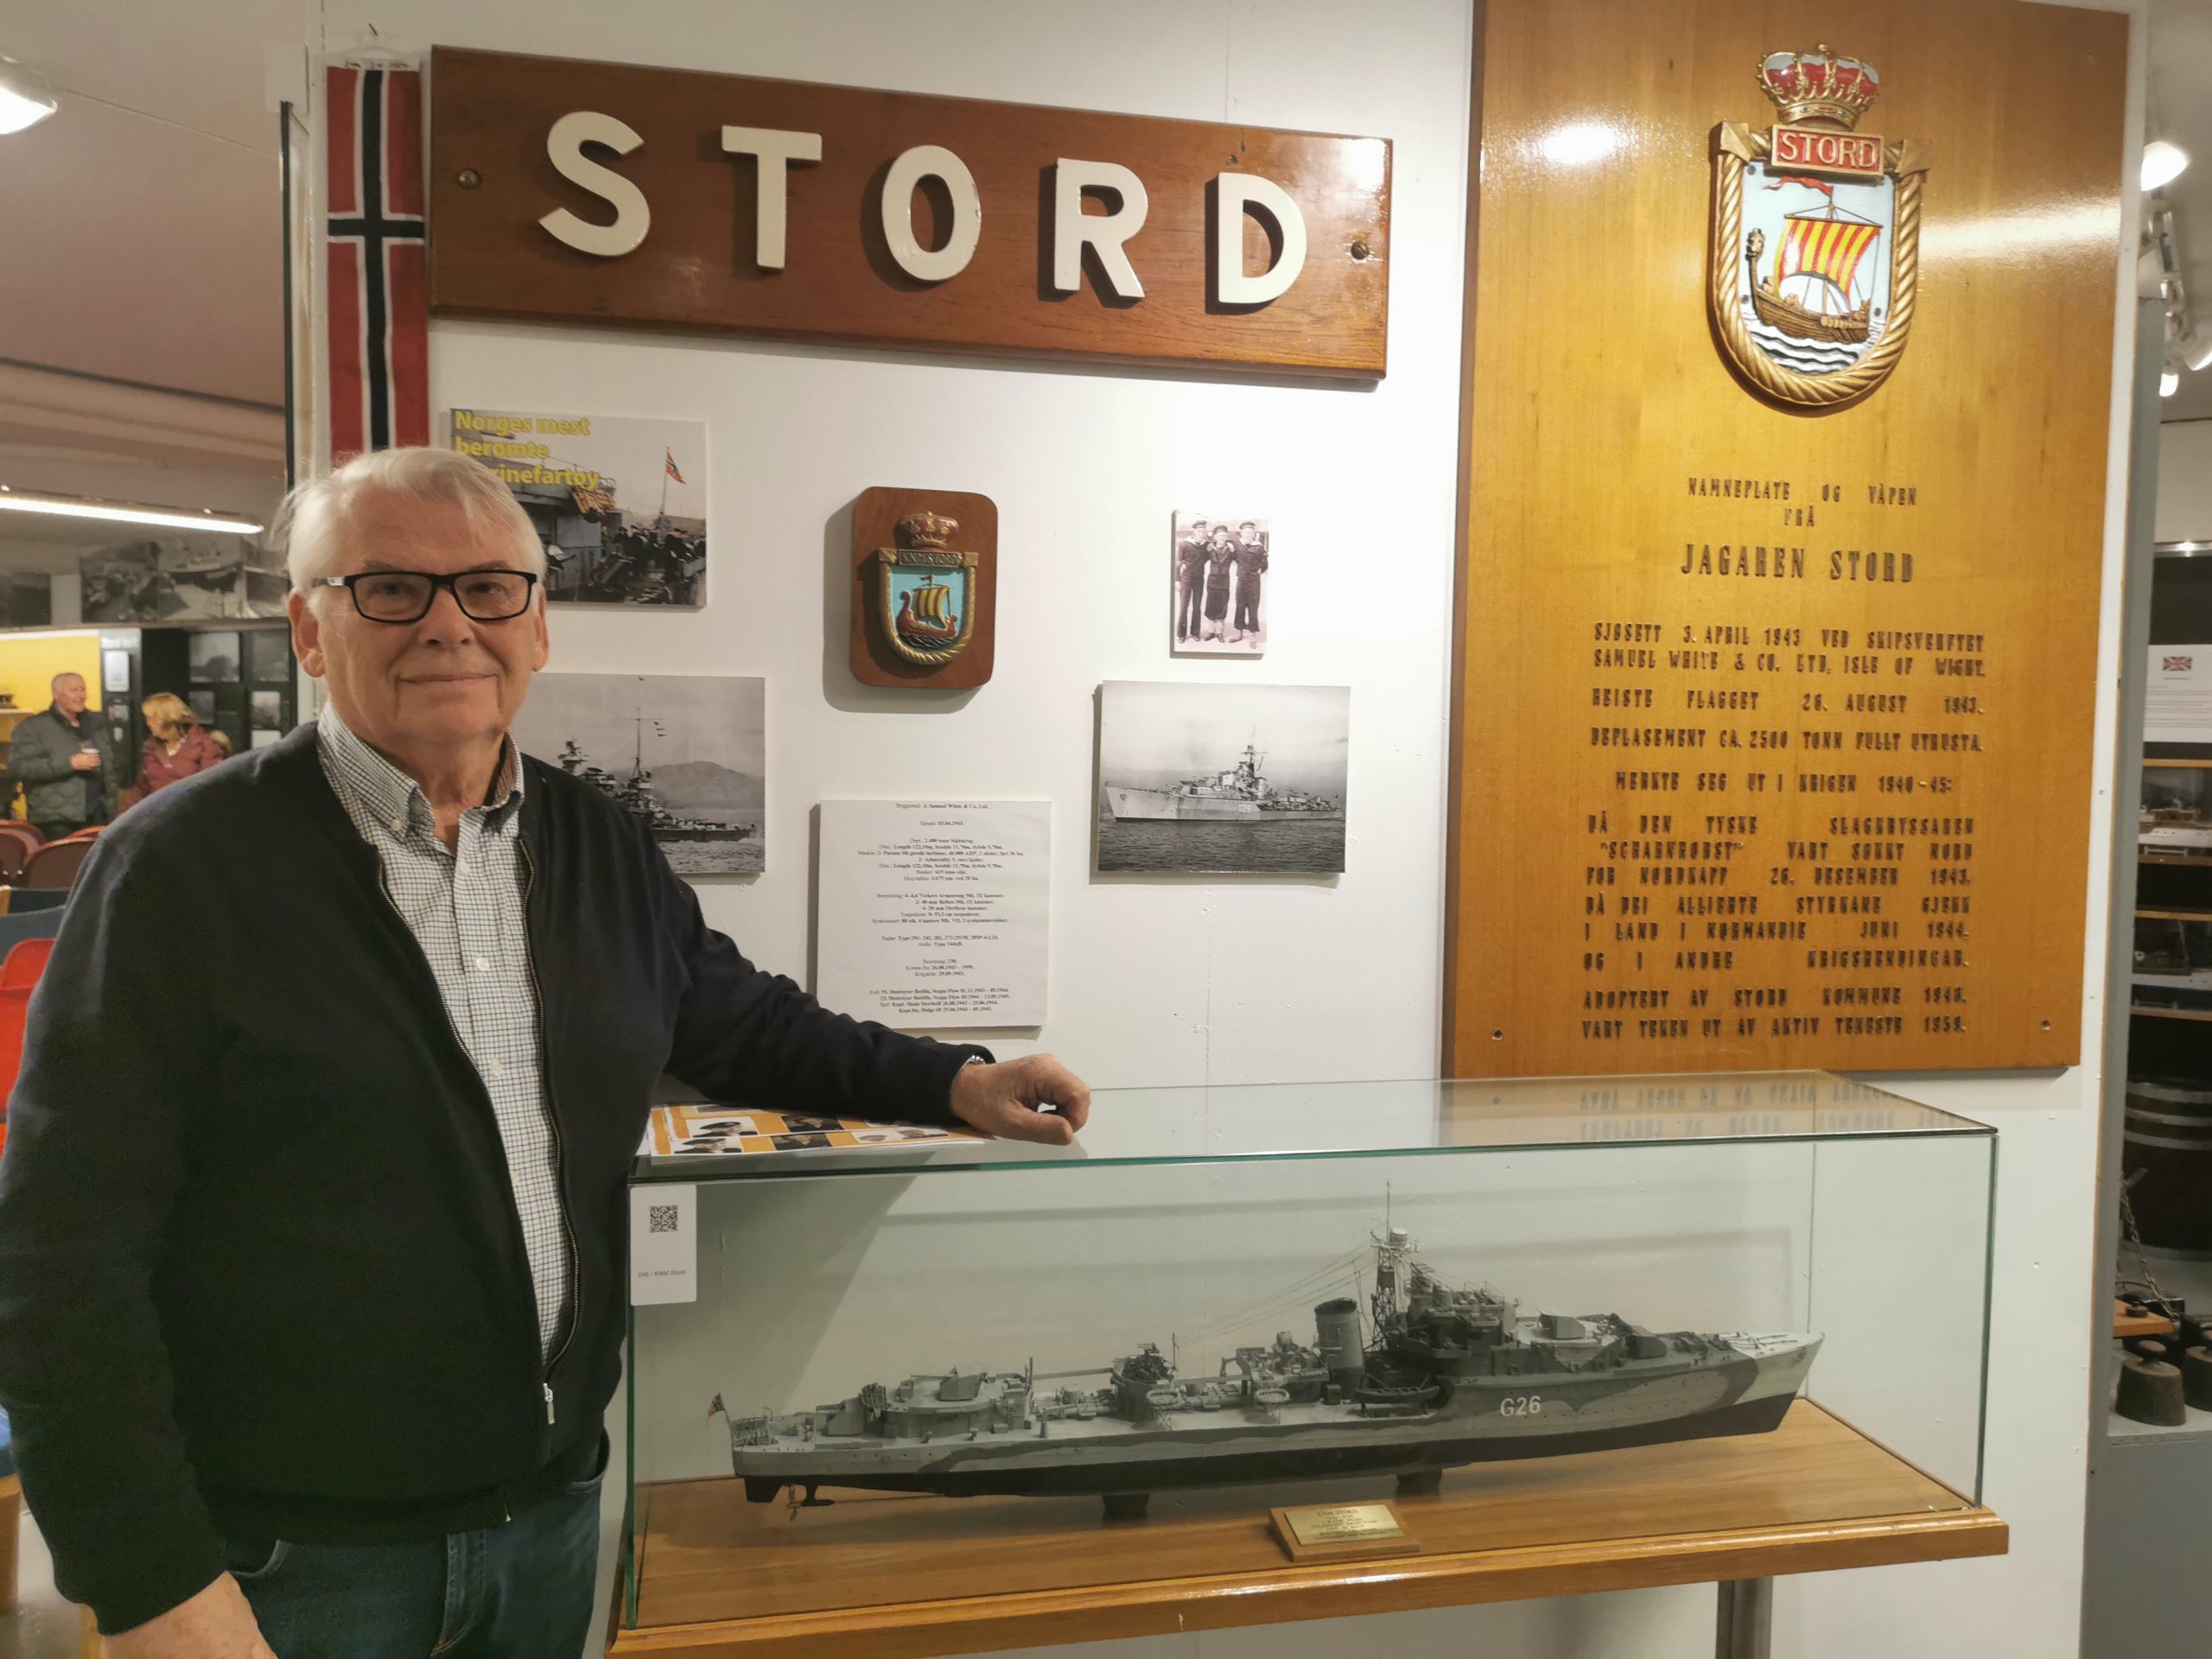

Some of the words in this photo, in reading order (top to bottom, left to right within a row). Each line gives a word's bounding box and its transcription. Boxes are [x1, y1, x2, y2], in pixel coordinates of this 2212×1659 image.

[1780, 132, 1879, 168] STORD
[537, 111, 1307, 303] STORD
[454, 410, 533, 436] Norges
[536, 417, 591, 436] mest
[1688, 477, 1790, 499] NAMNEPLATE
[1821, 484, 1841, 502] OG
[1868, 483, 1916, 505] VÅPEN
[1681, 543, 1805, 579] JAGAREN
[1830, 550, 1914, 582] STORD
[1706, 626, 1751, 645] APRIL
[1764, 627, 1801, 650] 1943
[1821, 629, 1849, 648] VED
[1867, 631, 1985, 652] SKIPSVERFTET
[1594, 648, 1656, 669] SAMUEL
[1669, 650, 1719, 671] WHITE
[1734, 653, 1745, 671] &
[1843, 655, 1878, 675] ISLE
[1895, 657, 1914, 676] OF
[1592, 688, 1653, 709] HEISTE
[1687, 690, 1760, 710] FLAGGET
[1846, 694, 1908, 714] AUGUST
[1591, 727, 1707, 748] DEPLASEMENT
[1750, 730, 1788, 750] 2500
[1802, 731, 1842, 751] TONN
[1856, 732, 1902, 751] FULLT
[1616, 771, 1680, 791] MERKTE
[1697, 772, 1727, 791] SEG
[1748, 772, 1767, 792] UT
[1777, 773, 1783, 793] I
[1799, 773, 1857, 793] KRIGEN
[1640, 815, 1672, 835] DEN
[1706, 816, 1758, 836] TYSKE
[1829, 817, 1974, 836] SLAGKRYSSAREN
[1787, 842, 1828, 861] VART
[1929, 842, 1973, 861] NORD
[1586, 867, 1615, 886] FOR
[1640, 867, 1727, 886] NORDKAPP
[1815, 868, 1898, 886] DESEMBER
[1621, 896, 1649, 916] DEI
[1677, 896, 1758, 916] ALLIERTE
[1796, 896, 1880, 915] STYRKANE
[1615, 921, 1658, 942] LAND
[1707, 922, 1806, 942] NORMANDIE
[1859, 921, 1898, 939] JUNI
[1584, 952, 1605, 971] OG
[1675, 951, 1732, 971] ANDRE
[1583, 989, 1669, 1009] ADOPTERT
[1689, 988, 1709, 1008] AV
[1733, 988, 1786, 1007] STORD
[1822, 987, 1902, 1007] KOMMUNE
[1582, 1020, 1623, 1039] VART
[1639, 1019, 1688, 1039] TEKEN
[1702, 1018, 1721, 1038] UT
[1737, 1018, 1756, 1037] AV
[1771, 1017, 1820, 1037] AKTIV
[1835, 1016, 1902, 1035] TENESTE
[1499, 1395, 1541, 1418] G26
